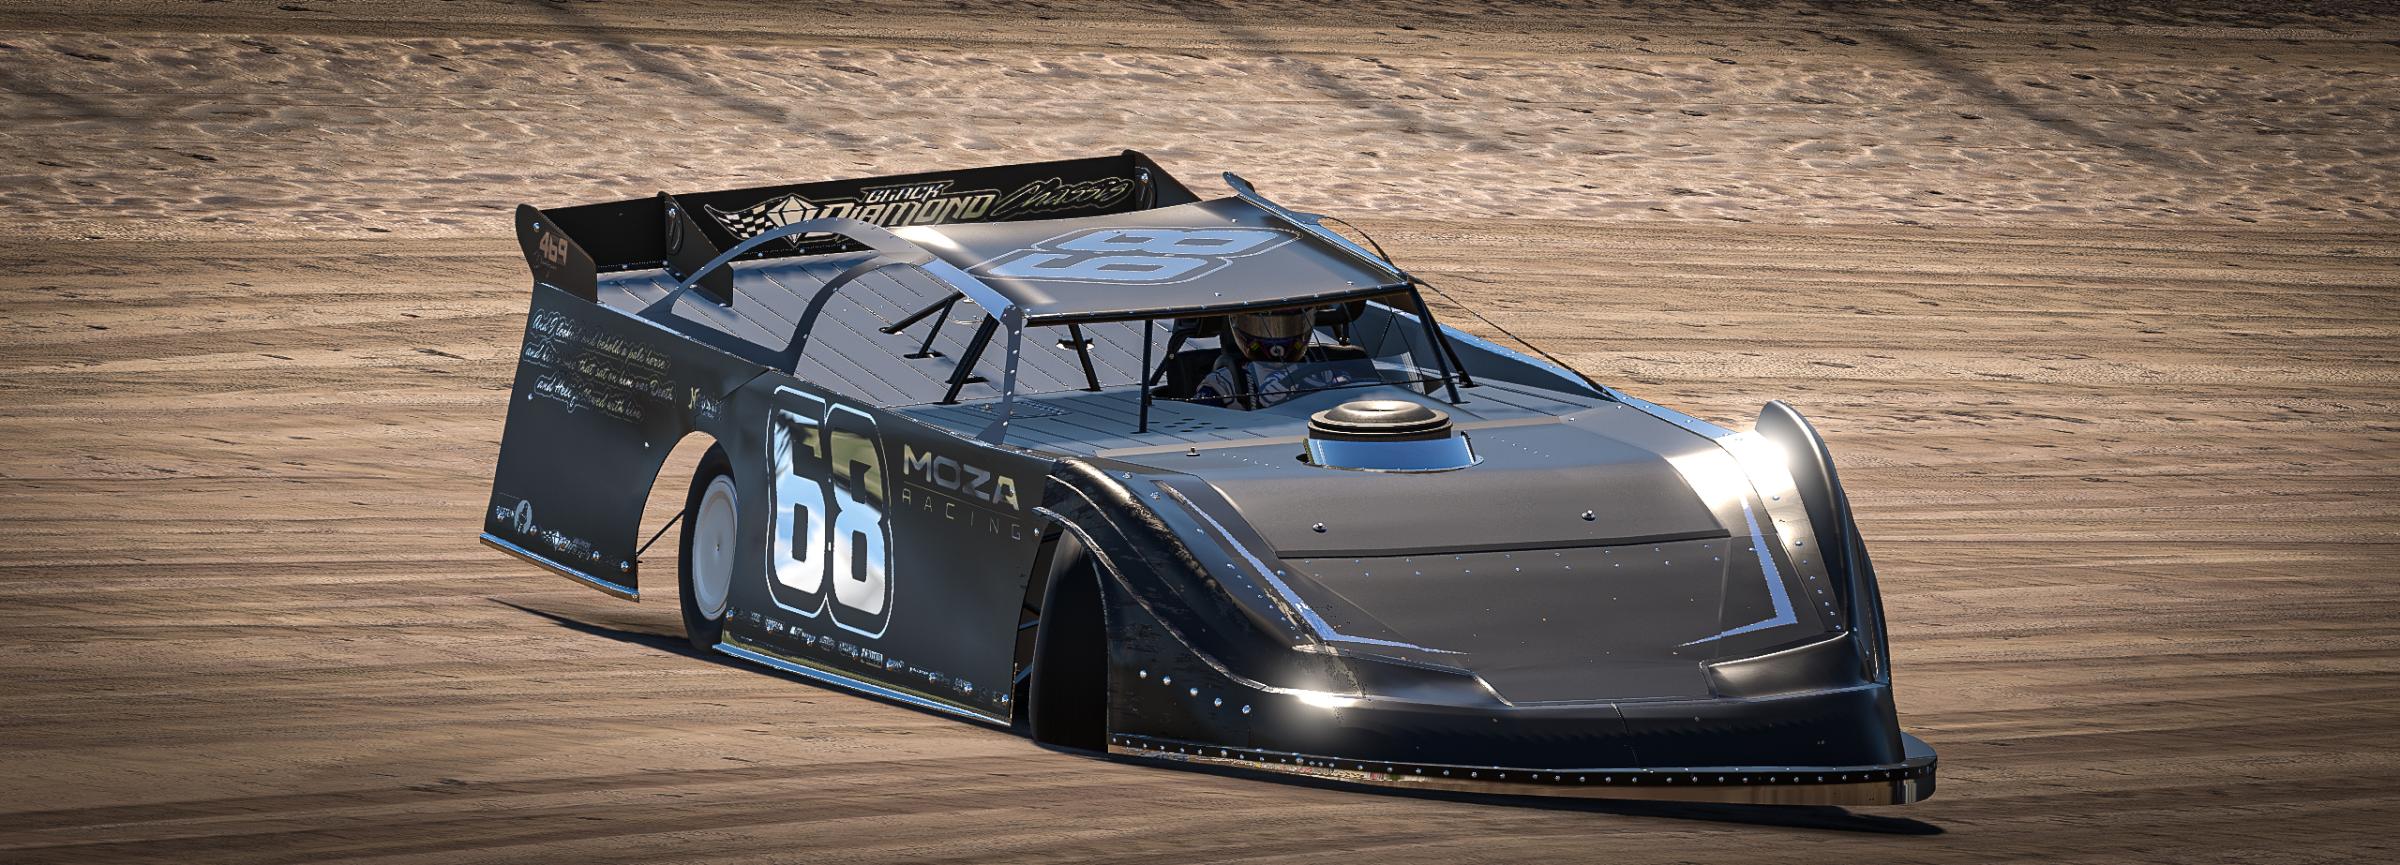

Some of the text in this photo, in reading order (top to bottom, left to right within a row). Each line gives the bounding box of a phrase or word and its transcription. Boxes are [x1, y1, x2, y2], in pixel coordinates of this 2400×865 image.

[804, 193, 997, 237] DIAMOND
[865, 183, 945, 203] BLACK
[539, 231, 569, 266] 469
[985, 228, 1282, 283] 68
[903, 443, 1020, 511] MOZA
[771, 405, 887, 619] 68
[901, 487, 1021, 541] RACING
